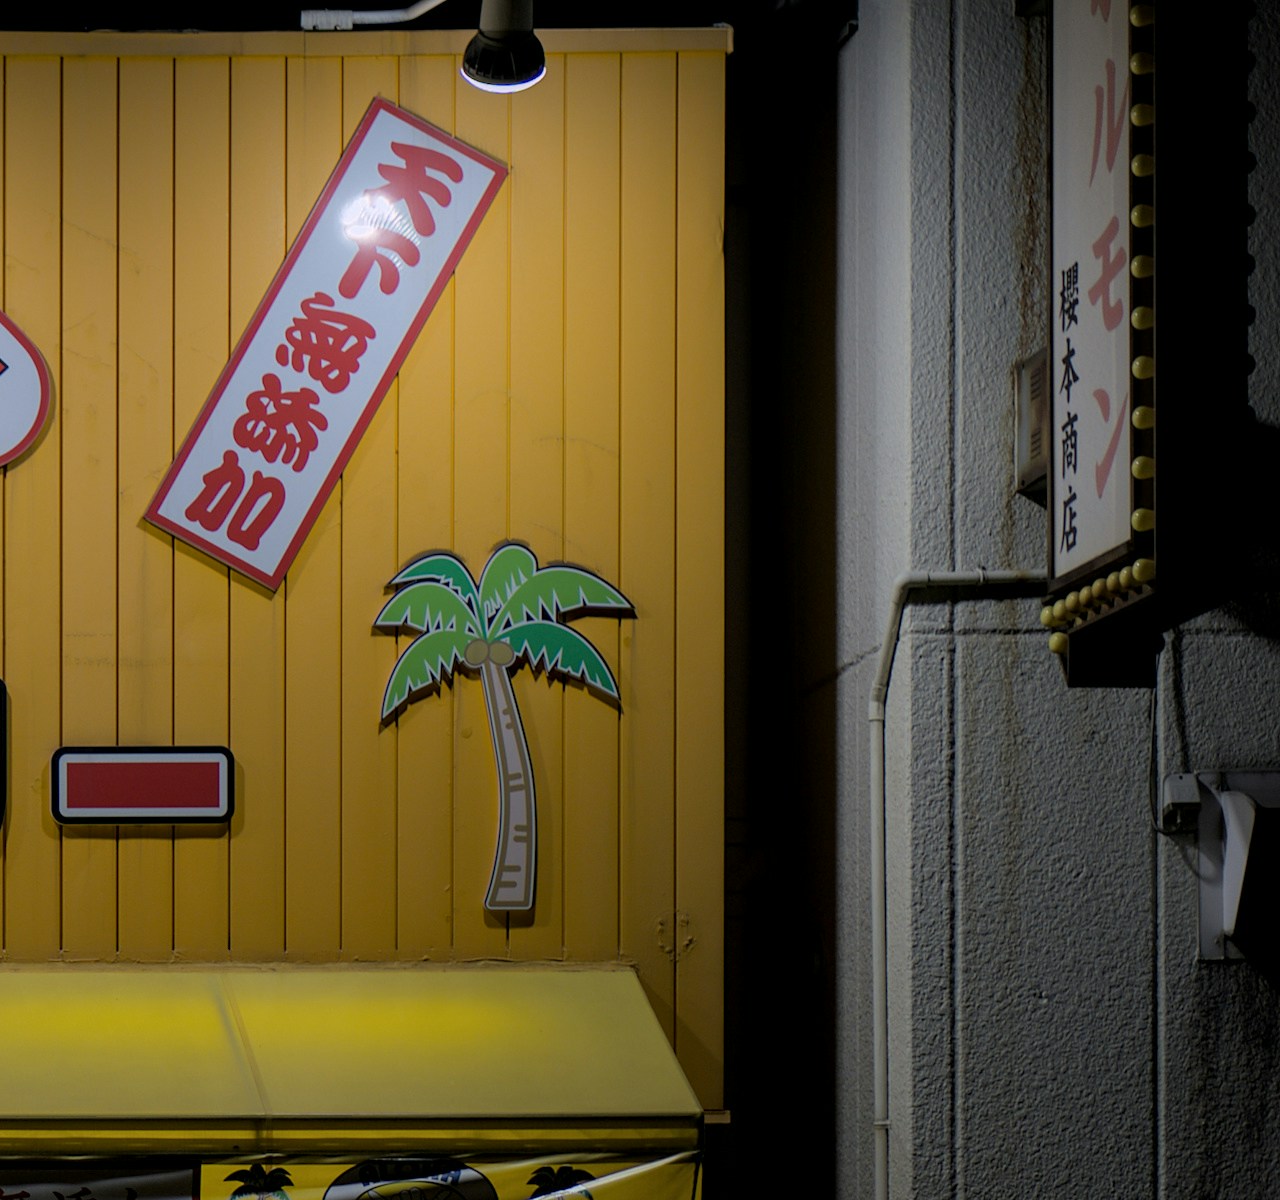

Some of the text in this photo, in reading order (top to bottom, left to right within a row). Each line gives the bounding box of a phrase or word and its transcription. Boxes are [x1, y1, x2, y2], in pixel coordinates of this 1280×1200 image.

[185, 141, 464, 551] 天下無添加
[1059, 262, 1078, 552] 櫻本商店
[1091, 0, 1127, 498] ルモン
